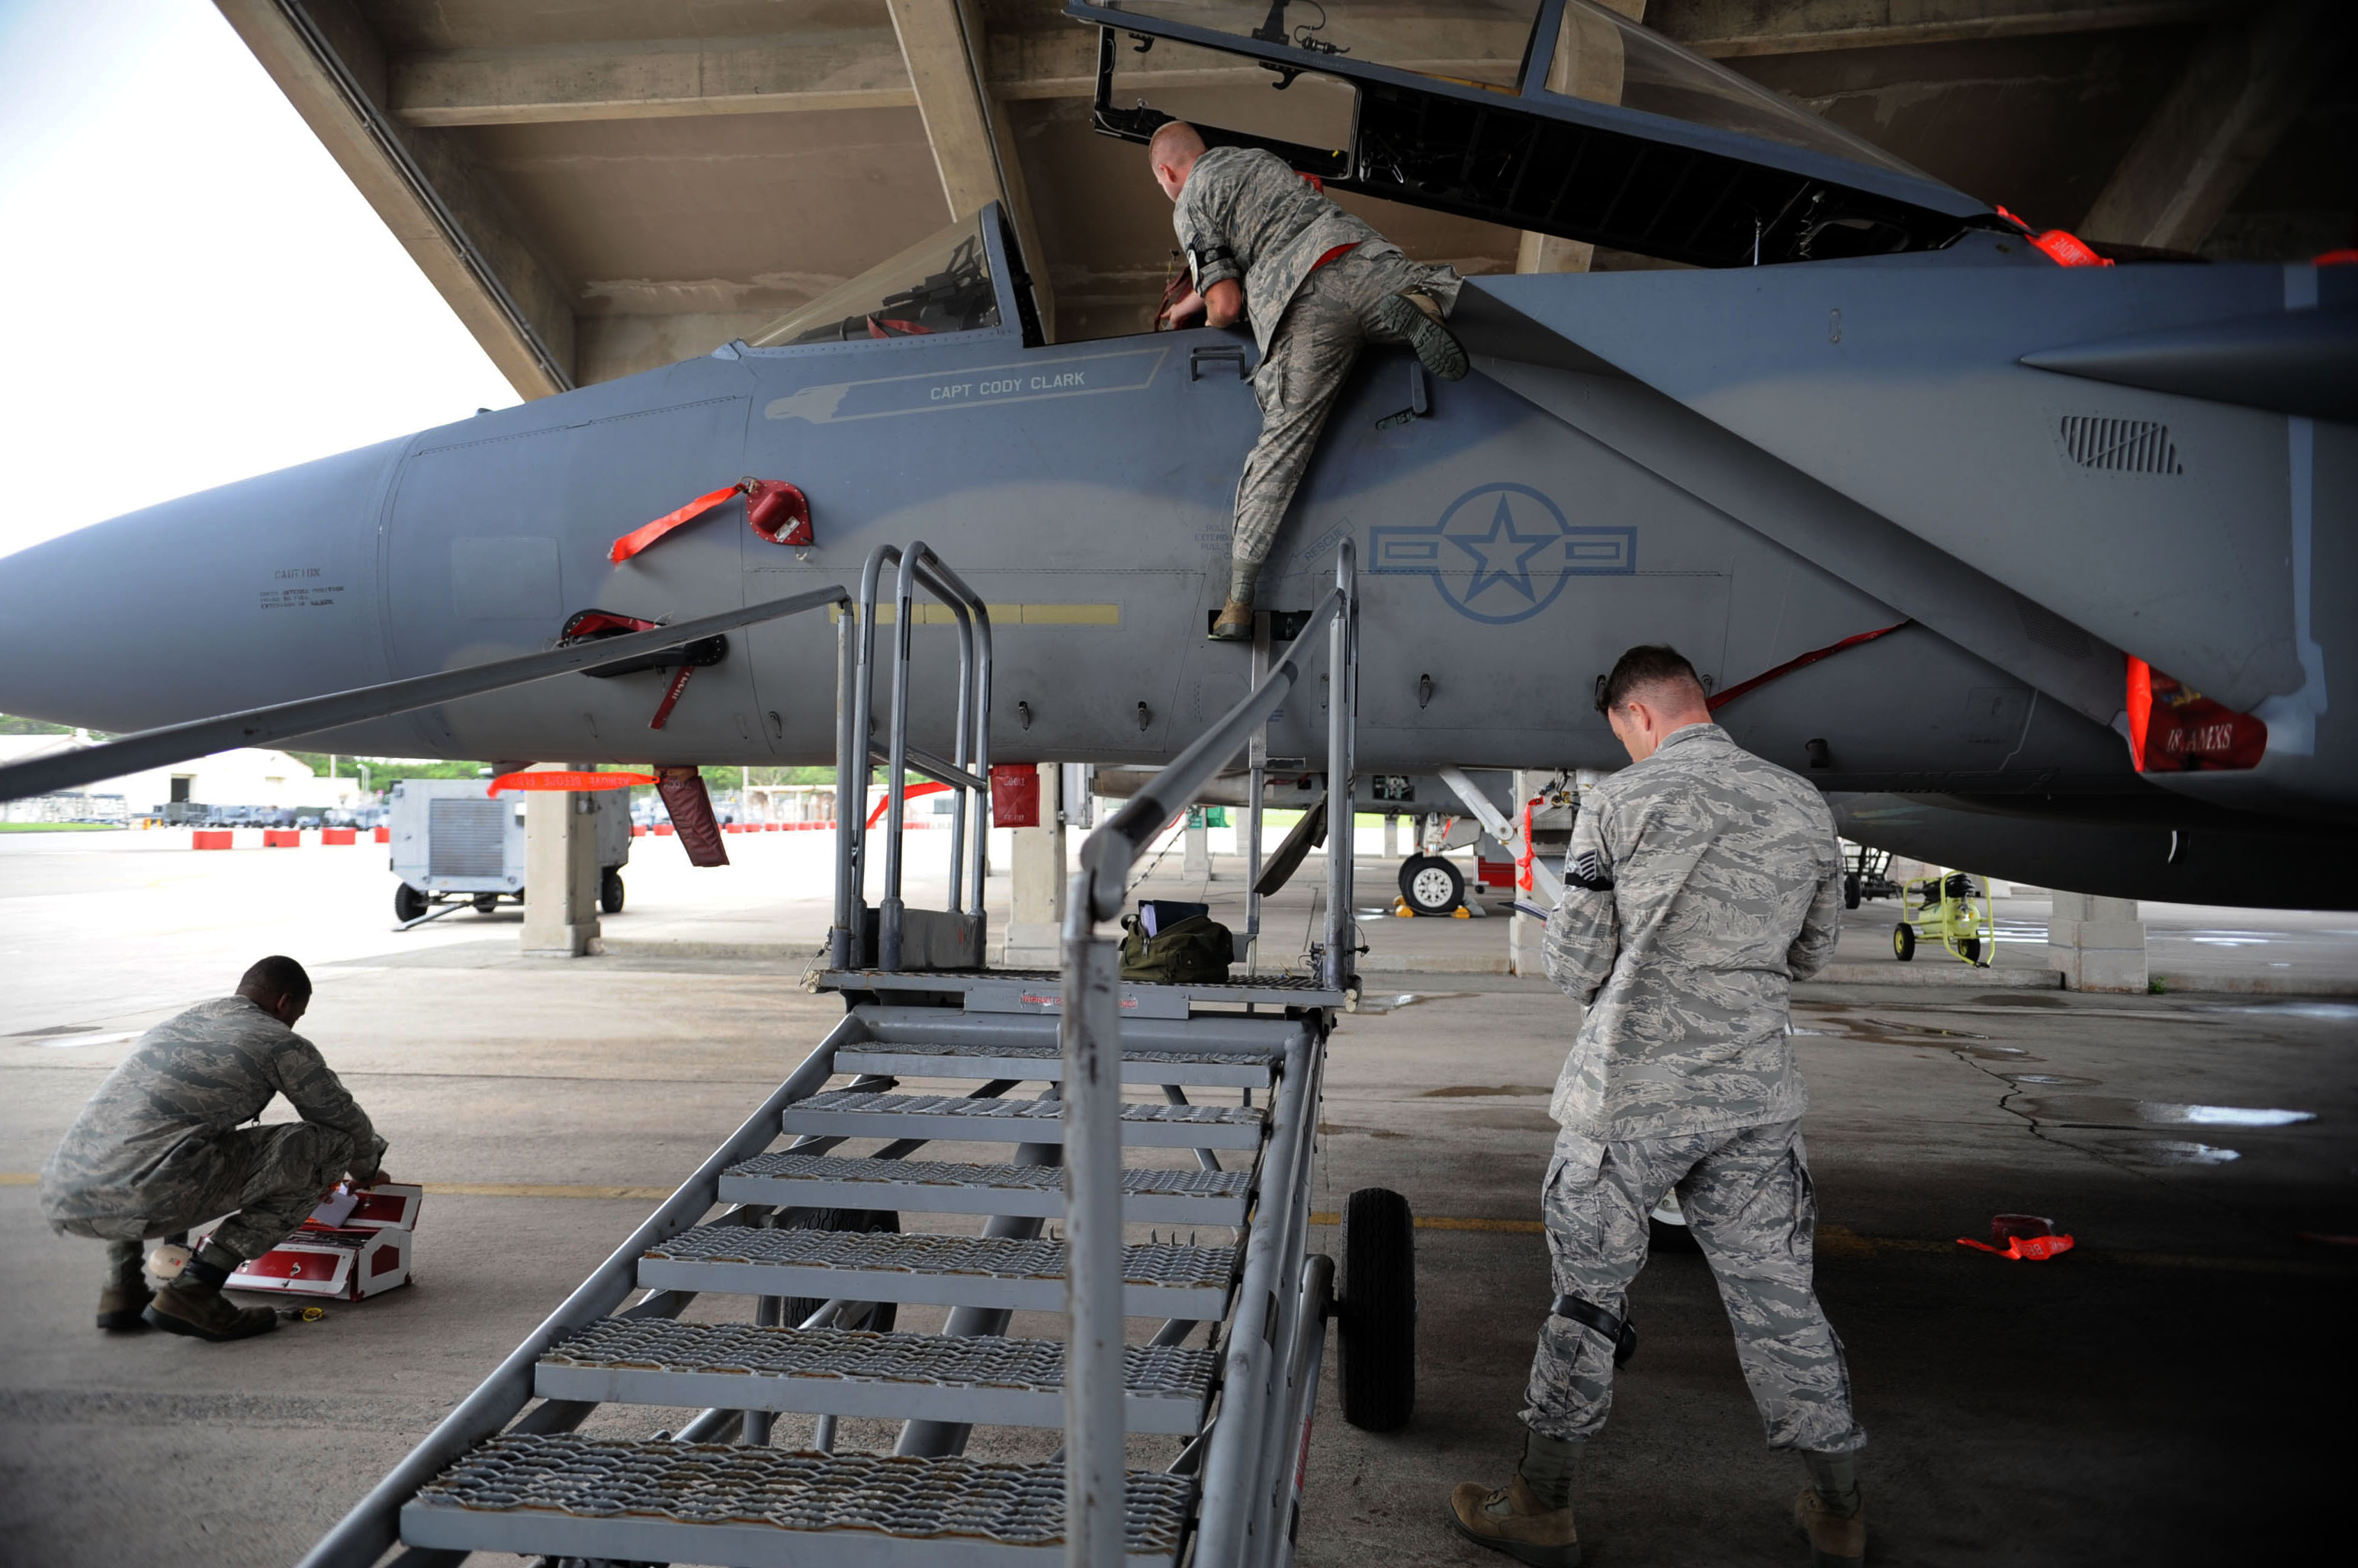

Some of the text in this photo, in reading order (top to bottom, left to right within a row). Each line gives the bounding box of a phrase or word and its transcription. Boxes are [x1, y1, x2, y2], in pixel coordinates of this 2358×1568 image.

[930, 371, 1085, 400] CAPT CODY CLARK
[1304, 525, 1345, 561] RESCUE
[275, 567, 320, 579] CAUTION
[2167, 728, 2183, 753] 18
